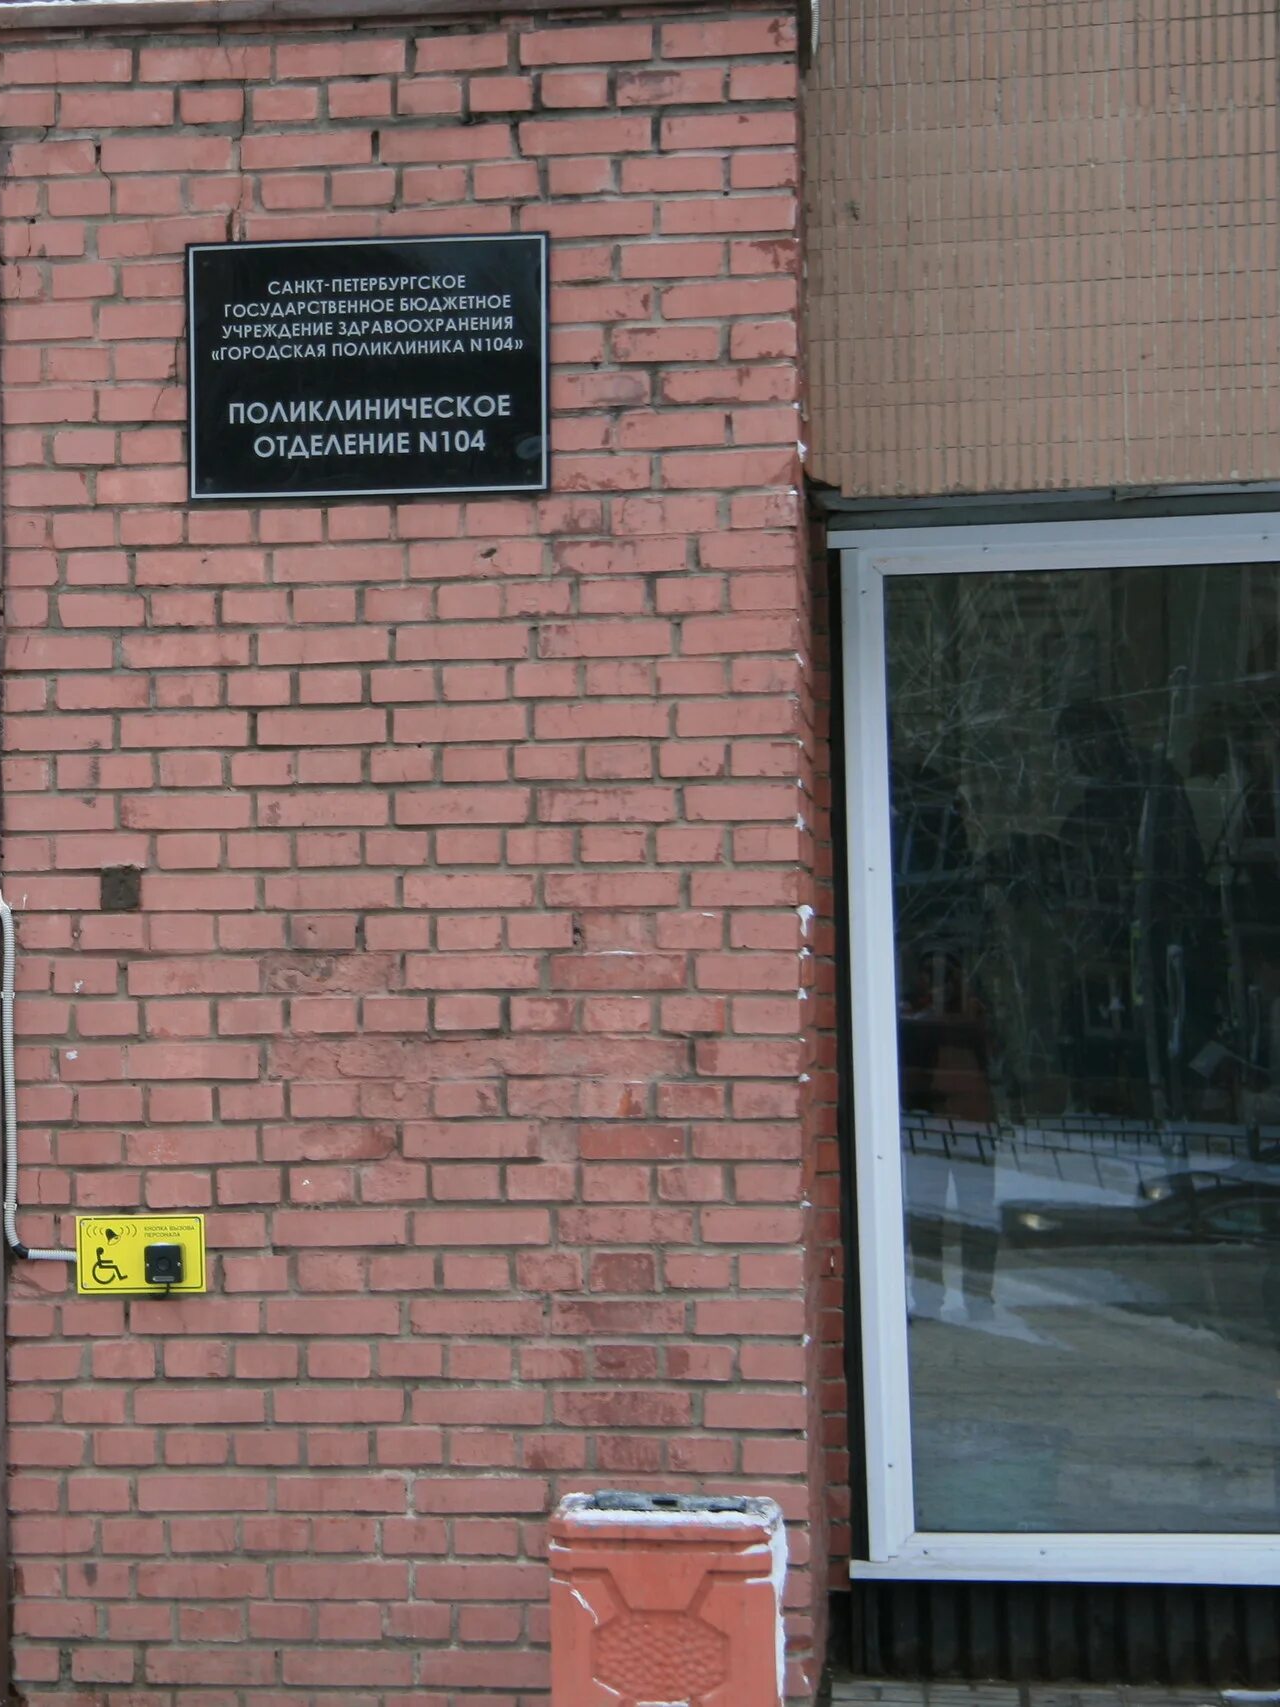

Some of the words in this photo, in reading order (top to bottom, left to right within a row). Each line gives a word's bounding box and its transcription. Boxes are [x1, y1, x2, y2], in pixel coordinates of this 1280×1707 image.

[268, 275, 466, 295] САНКТ-ПЕТЕРБУРГСКОЕ
[224, 298, 394, 318] ГОСУДАРСТВЕННОЕ
[400, 295, 511, 313] БЮДЖЕТНОЕ
[222, 322, 333, 340] УЧРЕЖДЕНИЕ
[338, 316, 514, 337] ЗДРАВООХРАНЕНИЯ
[211, 344, 326, 361] «ГОРОДСКАЯ
[332, 339, 465, 357] ПОЛИКЛИНИКА
[470, 337, 524, 352] N104»
[229, 394, 511, 424] ПОЛИКЛИНИЧЕСКОЕ
[254, 432, 410, 459] ОТДЕЛЕНИЕ
[419, 430, 486, 453] N104
